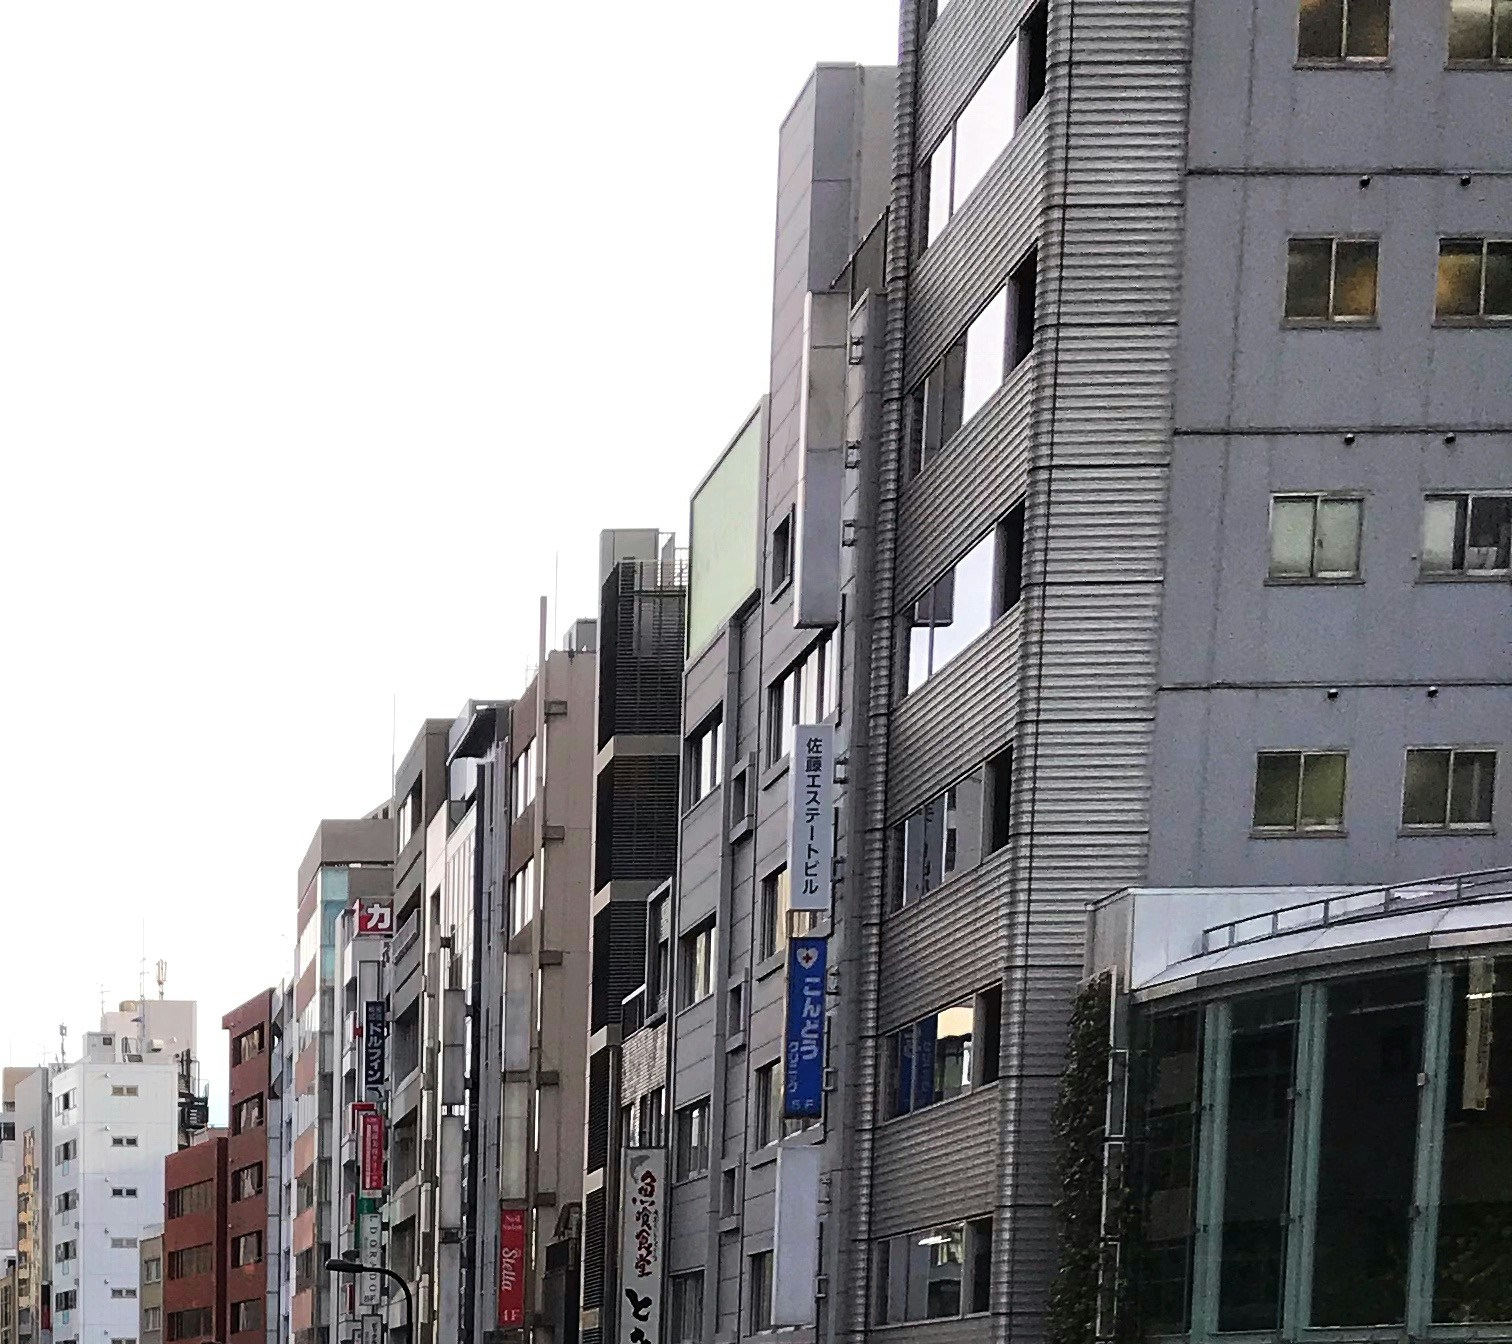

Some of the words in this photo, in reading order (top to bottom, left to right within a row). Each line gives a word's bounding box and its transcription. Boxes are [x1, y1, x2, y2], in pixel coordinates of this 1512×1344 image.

[802, 737, 823, 895] 佐藤エステートビル
[800, 977, 821, 1060] こんどう
[501, 1247, 522, 1292] Stella
[502, 1309, 520, 1322] 1F
